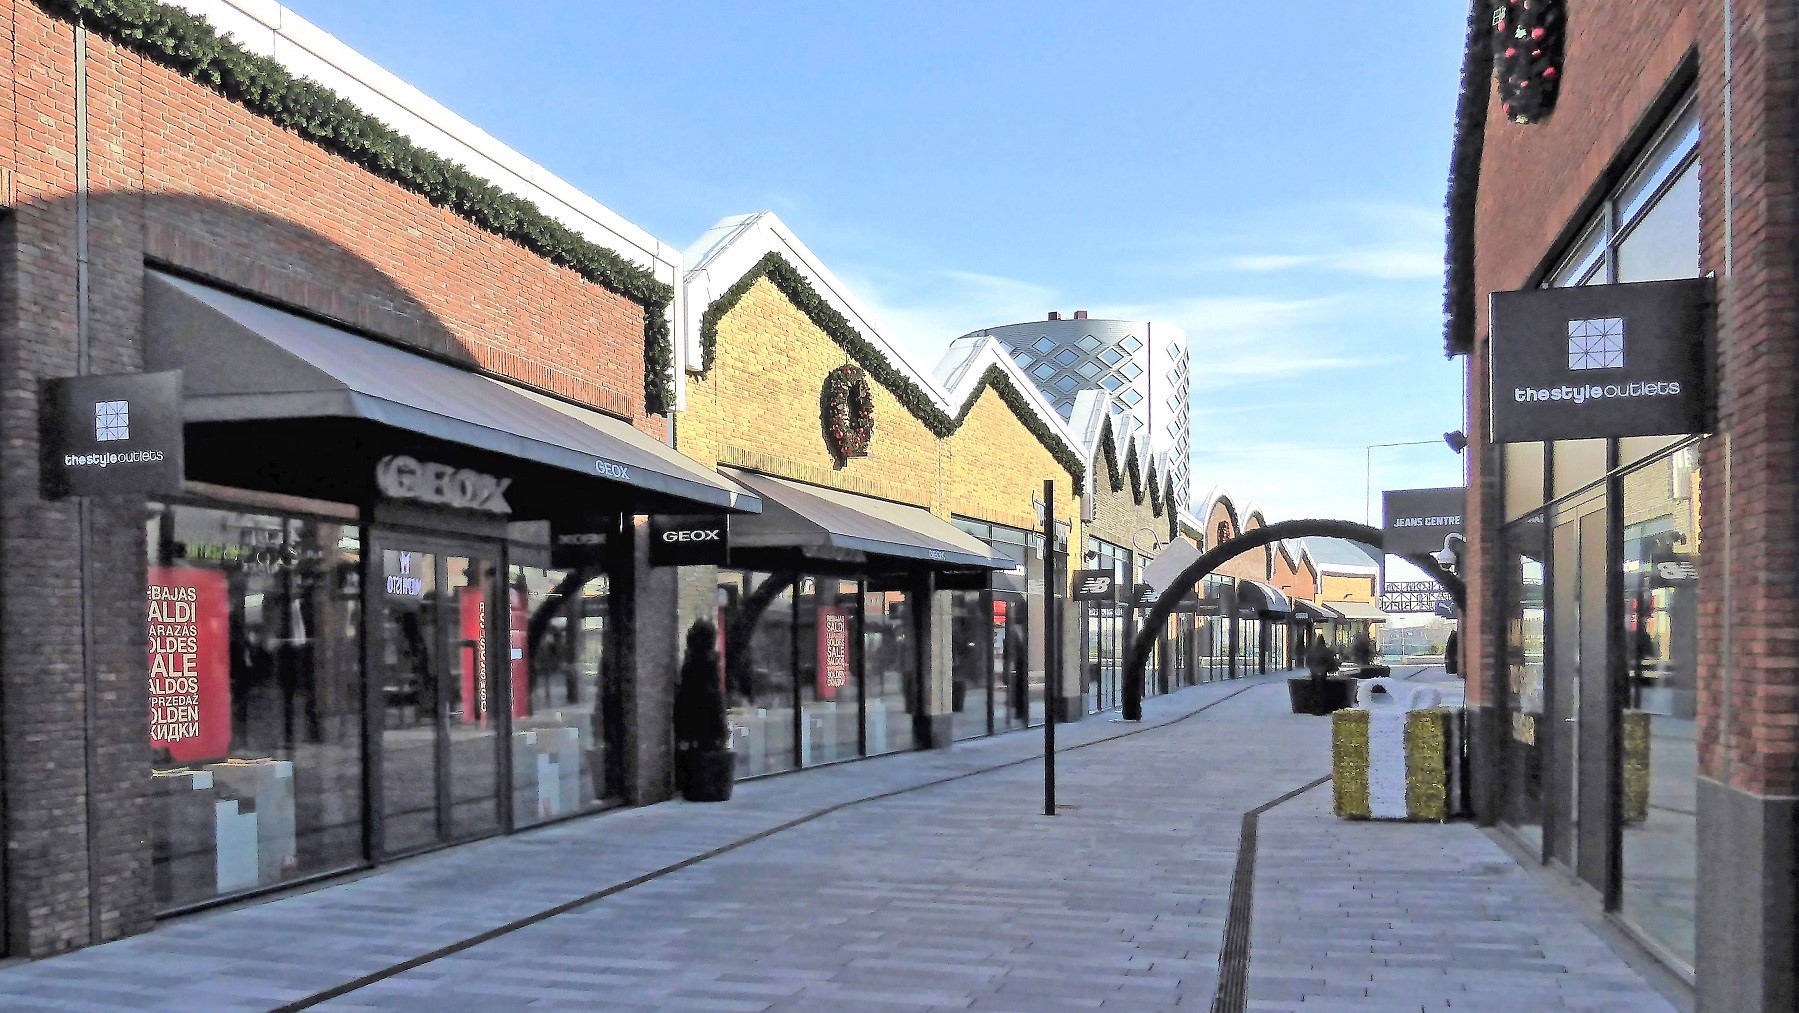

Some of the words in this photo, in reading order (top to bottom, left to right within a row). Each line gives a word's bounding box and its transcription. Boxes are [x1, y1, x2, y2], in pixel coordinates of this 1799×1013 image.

[595, 459, 630, 480] GEOX
[376, 454, 513, 514] GEOX
[1393, 517, 1423, 528] JEANS
[1424, 515, 1461, 526] CENTRE
[662, 529, 720, 542] GEOX
[826, 621, 845, 632] SALDI
[827, 646, 845, 657] SALE
[149, 653, 198, 678] ALE
[149, 693, 199, 707] PRZEDAŻ
